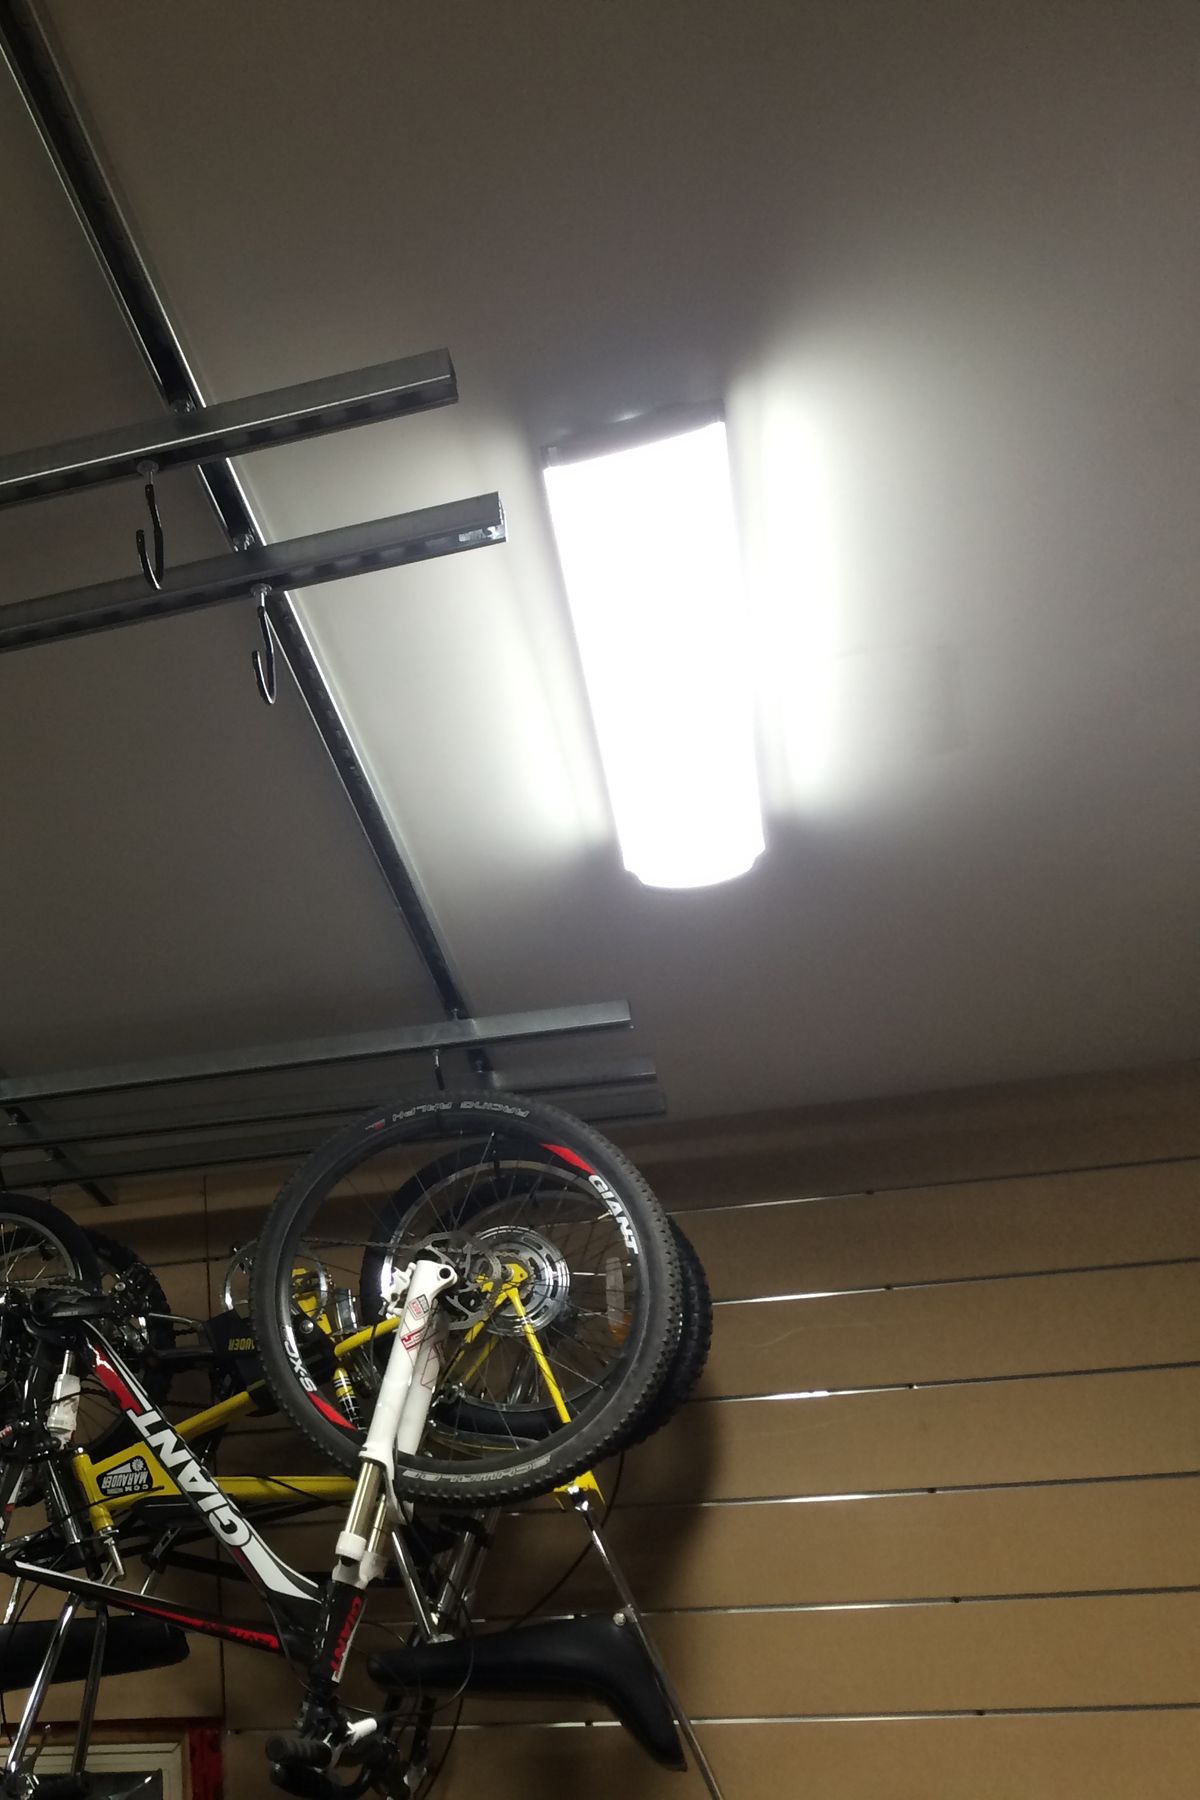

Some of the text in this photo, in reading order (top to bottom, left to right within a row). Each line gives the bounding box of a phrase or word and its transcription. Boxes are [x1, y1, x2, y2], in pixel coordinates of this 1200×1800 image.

[459, 1101, 530, 1118] RACING
[588, 1175, 639, 1254] GIANT
[101, 1471, 148, 1489] MARAUDER
[127, 1409, 253, 1547] GIANT
[329, 1596, 362, 1676] GIANT
